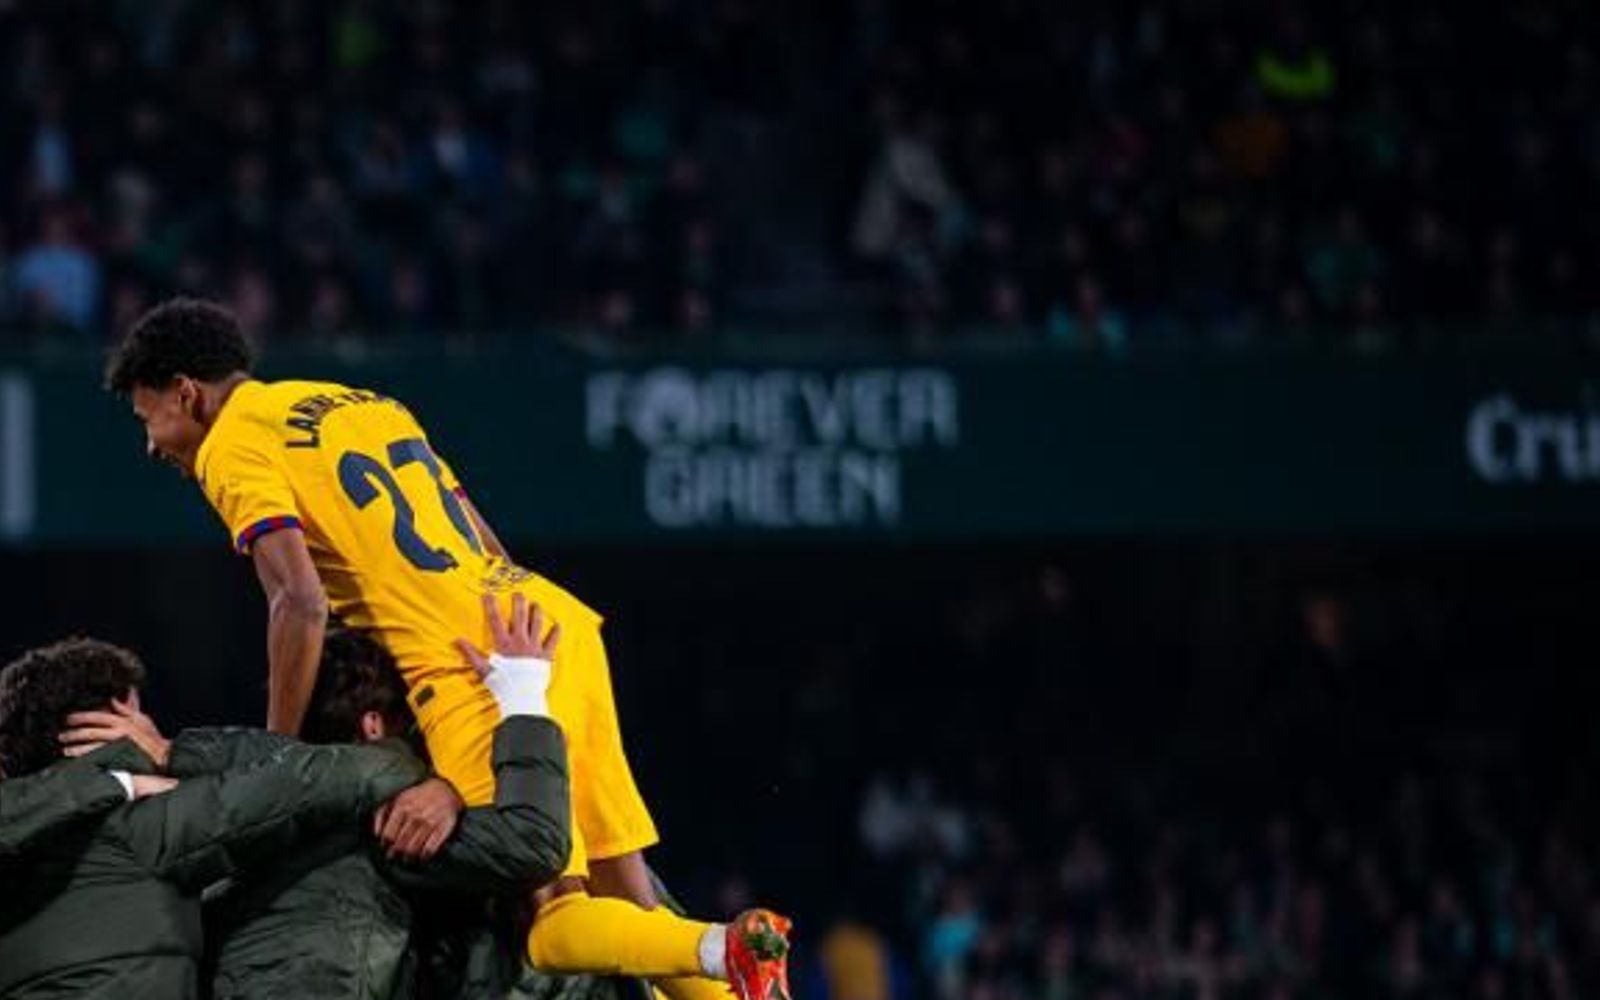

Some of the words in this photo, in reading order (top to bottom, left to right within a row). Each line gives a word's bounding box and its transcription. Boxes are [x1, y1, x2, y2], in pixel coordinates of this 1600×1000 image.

[584, 366, 961, 449] FOREVER
[337, 437, 483, 573] 27
[645, 448, 901, 530] GREEN
